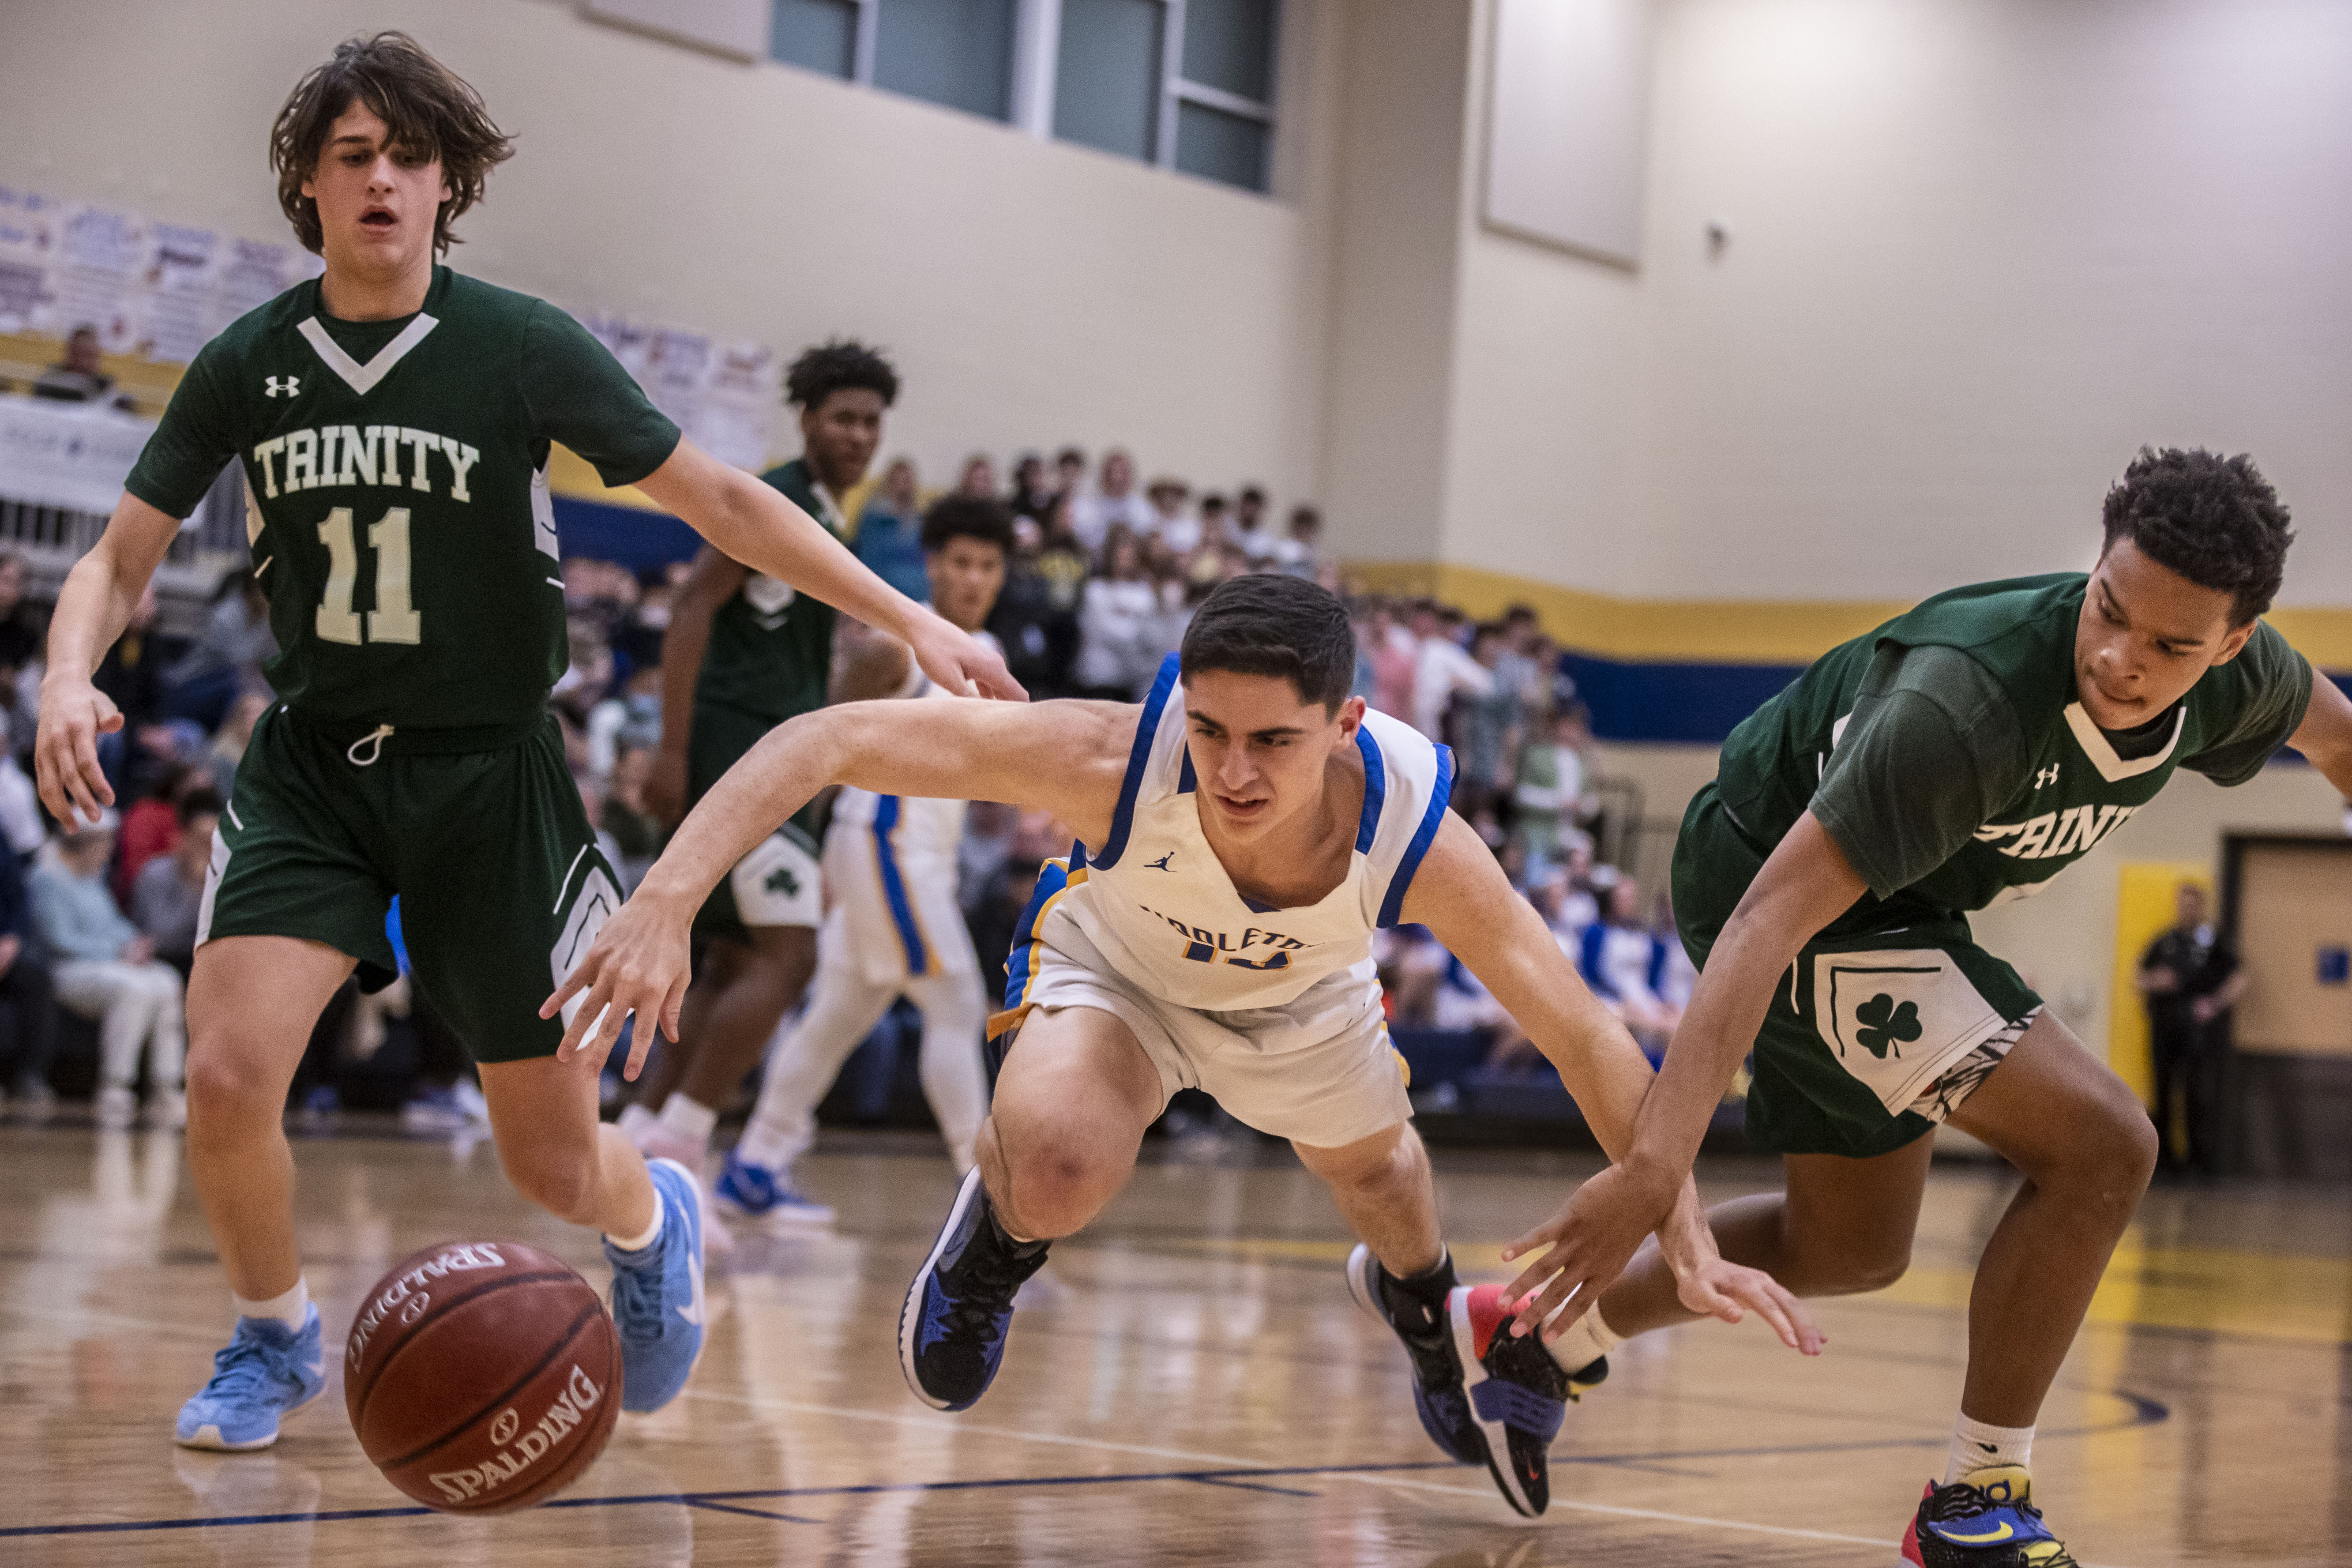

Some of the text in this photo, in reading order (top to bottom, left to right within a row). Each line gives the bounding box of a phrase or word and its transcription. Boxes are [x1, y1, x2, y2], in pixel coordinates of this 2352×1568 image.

[254, 425, 480, 503] TRINITY
[316, 507, 421, 646] 11
[1973, 804, 2143, 860] TRINI
[348, 1242, 505, 1373] SPALDING
[429, 1363, 601, 1503] SPALDING
